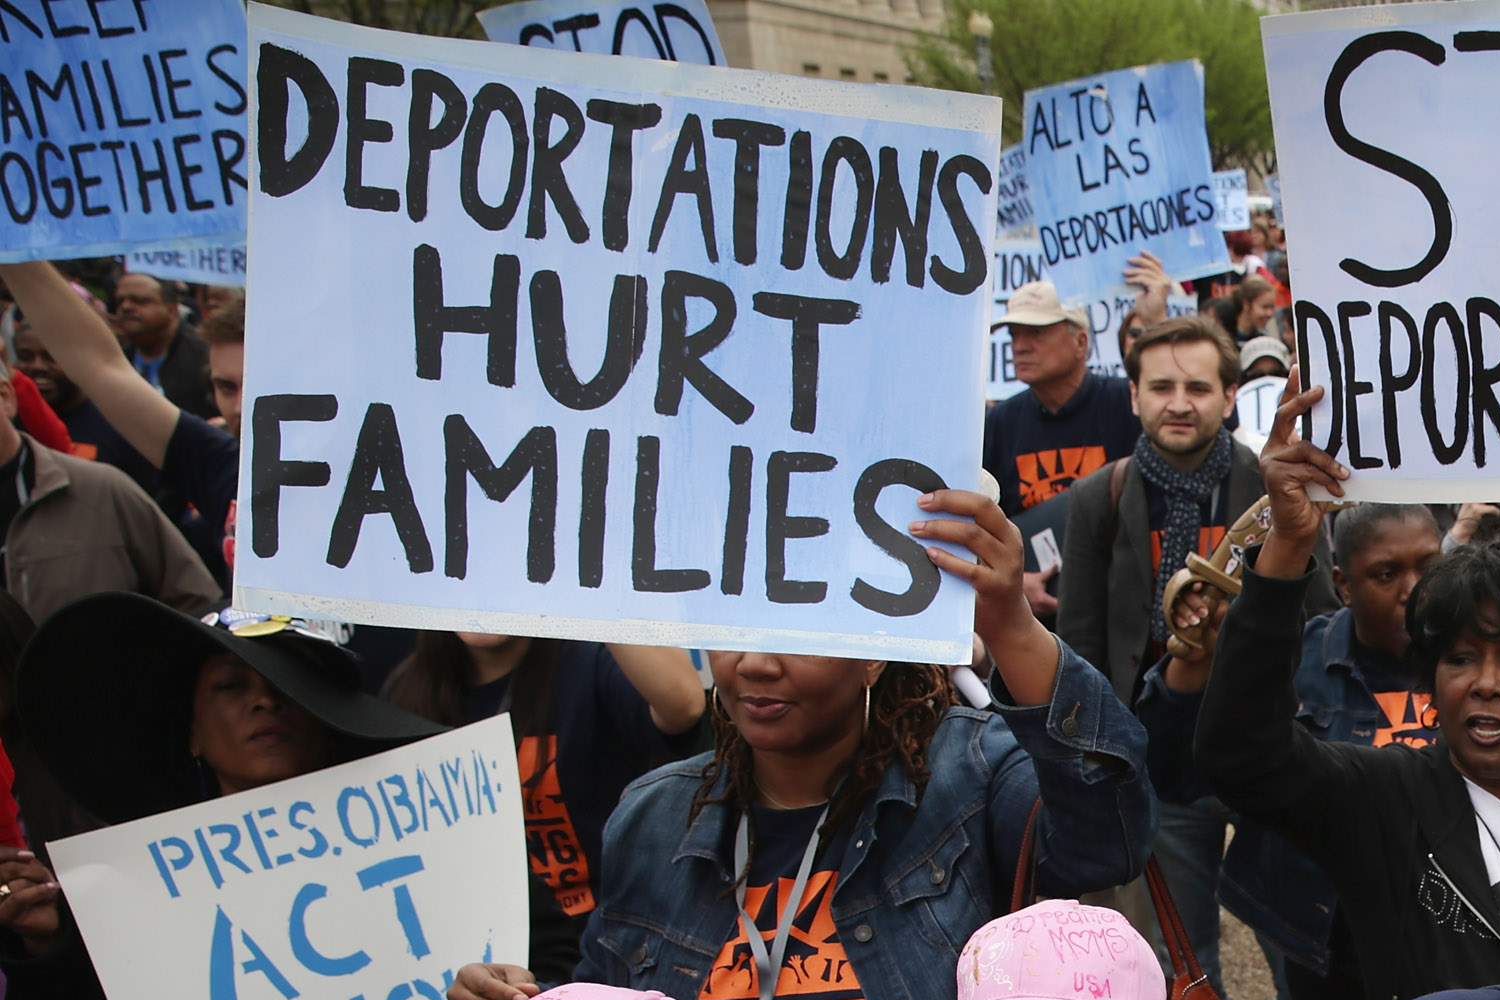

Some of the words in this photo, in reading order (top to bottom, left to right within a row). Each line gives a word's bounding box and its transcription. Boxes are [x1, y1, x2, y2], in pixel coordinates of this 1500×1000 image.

[257, 41, 991, 295] DEPORTATIONS
[1030, 86, 1114, 155] ALTO
[1136, 83, 1155, 124] A
[1076, 138, 1151, 192] LAS
[1040, 185, 1215, 266] DEPORTACIONES
[412, 243, 862, 433] HURT
[251, 394, 950, 617] FAMILIES
